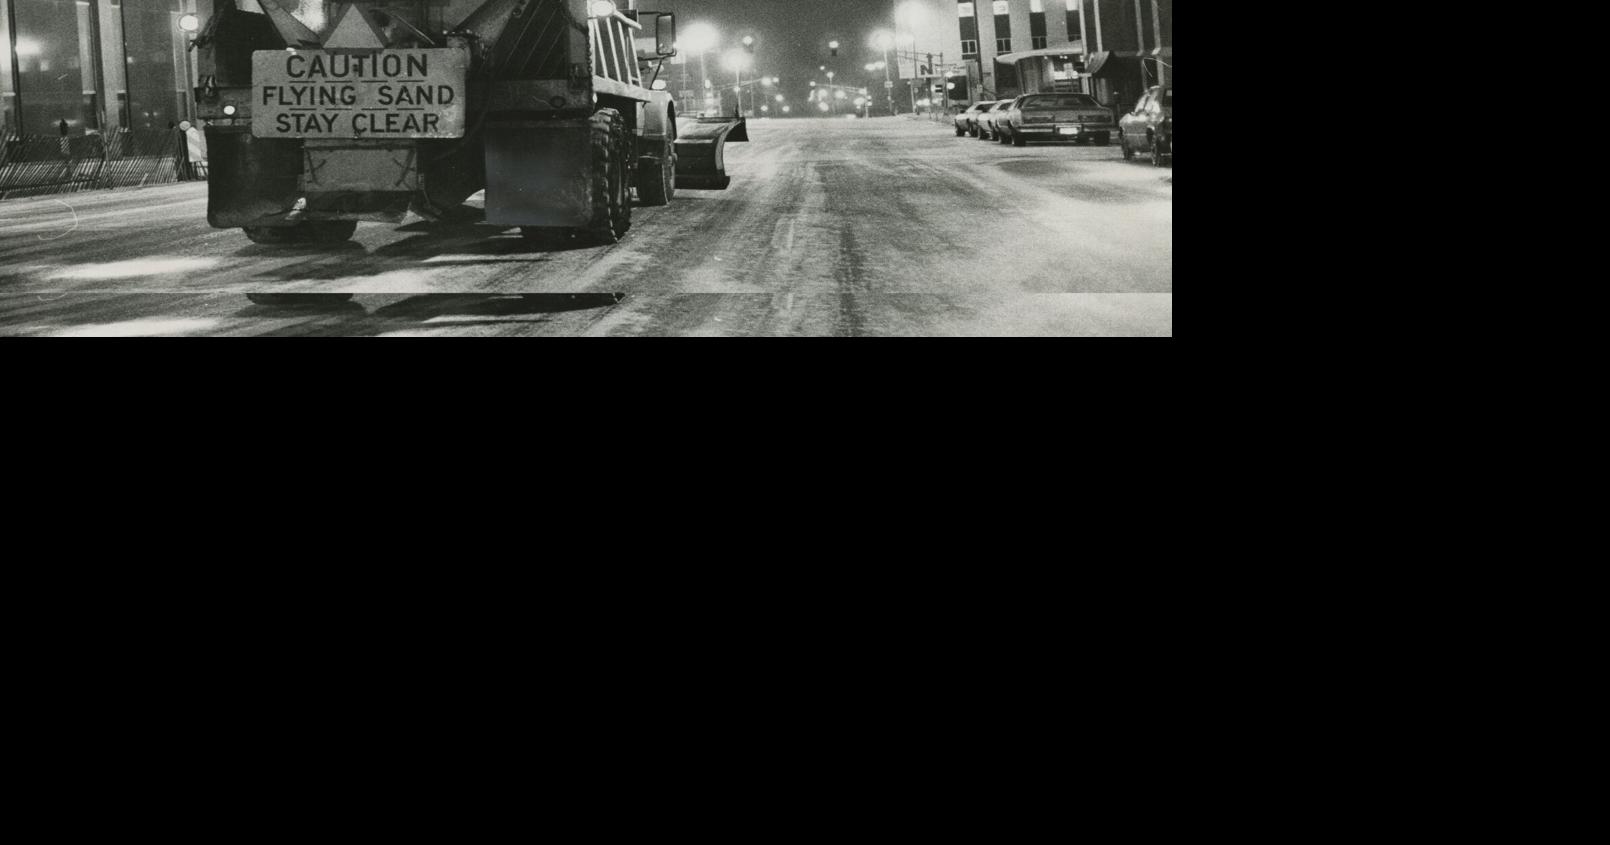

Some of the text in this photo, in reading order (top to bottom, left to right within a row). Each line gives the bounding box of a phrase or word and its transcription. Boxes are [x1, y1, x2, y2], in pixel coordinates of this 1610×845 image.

[285, 53, 428, 79] CAUTION
[262, 84, 455, 106] FLYING SAND
[275, 113, 440, 133] STAY CLEAR
